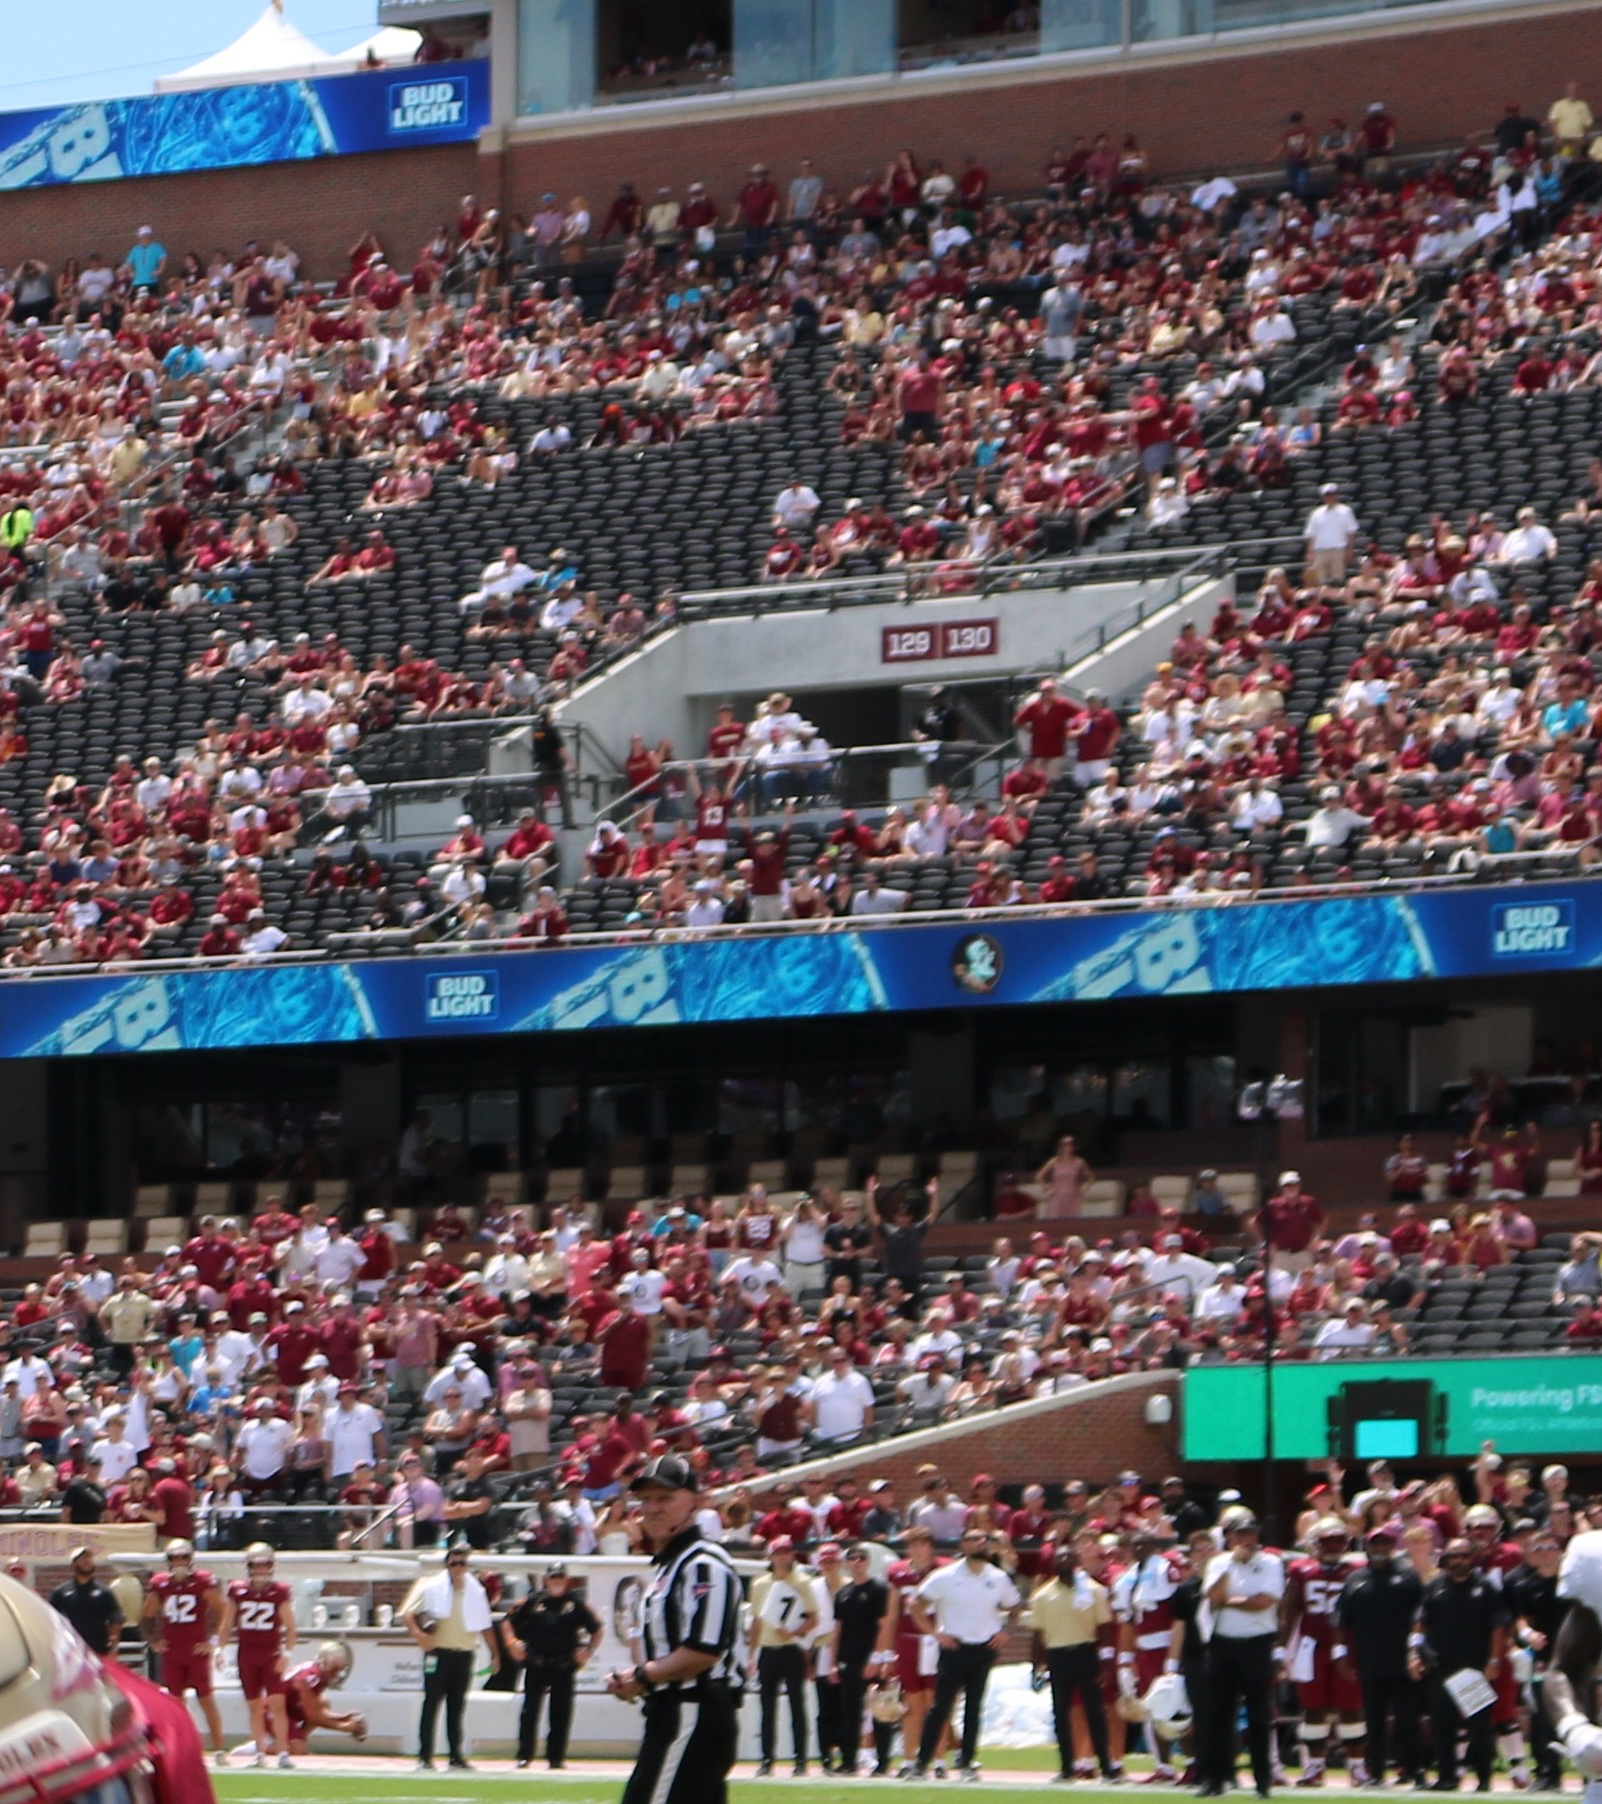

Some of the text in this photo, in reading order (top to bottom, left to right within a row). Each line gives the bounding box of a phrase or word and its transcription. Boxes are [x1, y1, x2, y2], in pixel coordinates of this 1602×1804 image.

[403, 83, 454, 107] BUD
[393, 101, 463, 129] LIGHT
[888, 630, 931, 655] 129
[947, 626, 992, 651] 130
[1505, 906, 1560, 929] BUD
[1496, 926, 1570, 952] LIGHT
[438, 975, 486, 997] BUD
[430, 994, 495, 1018] LIGHT
[1473, 1383, 1573, 1412] Powering
[164, 1593, 197, 1624] 42
[239, 1600, 275, 1631] 22
[779, 1596, 796, 1623] 7
